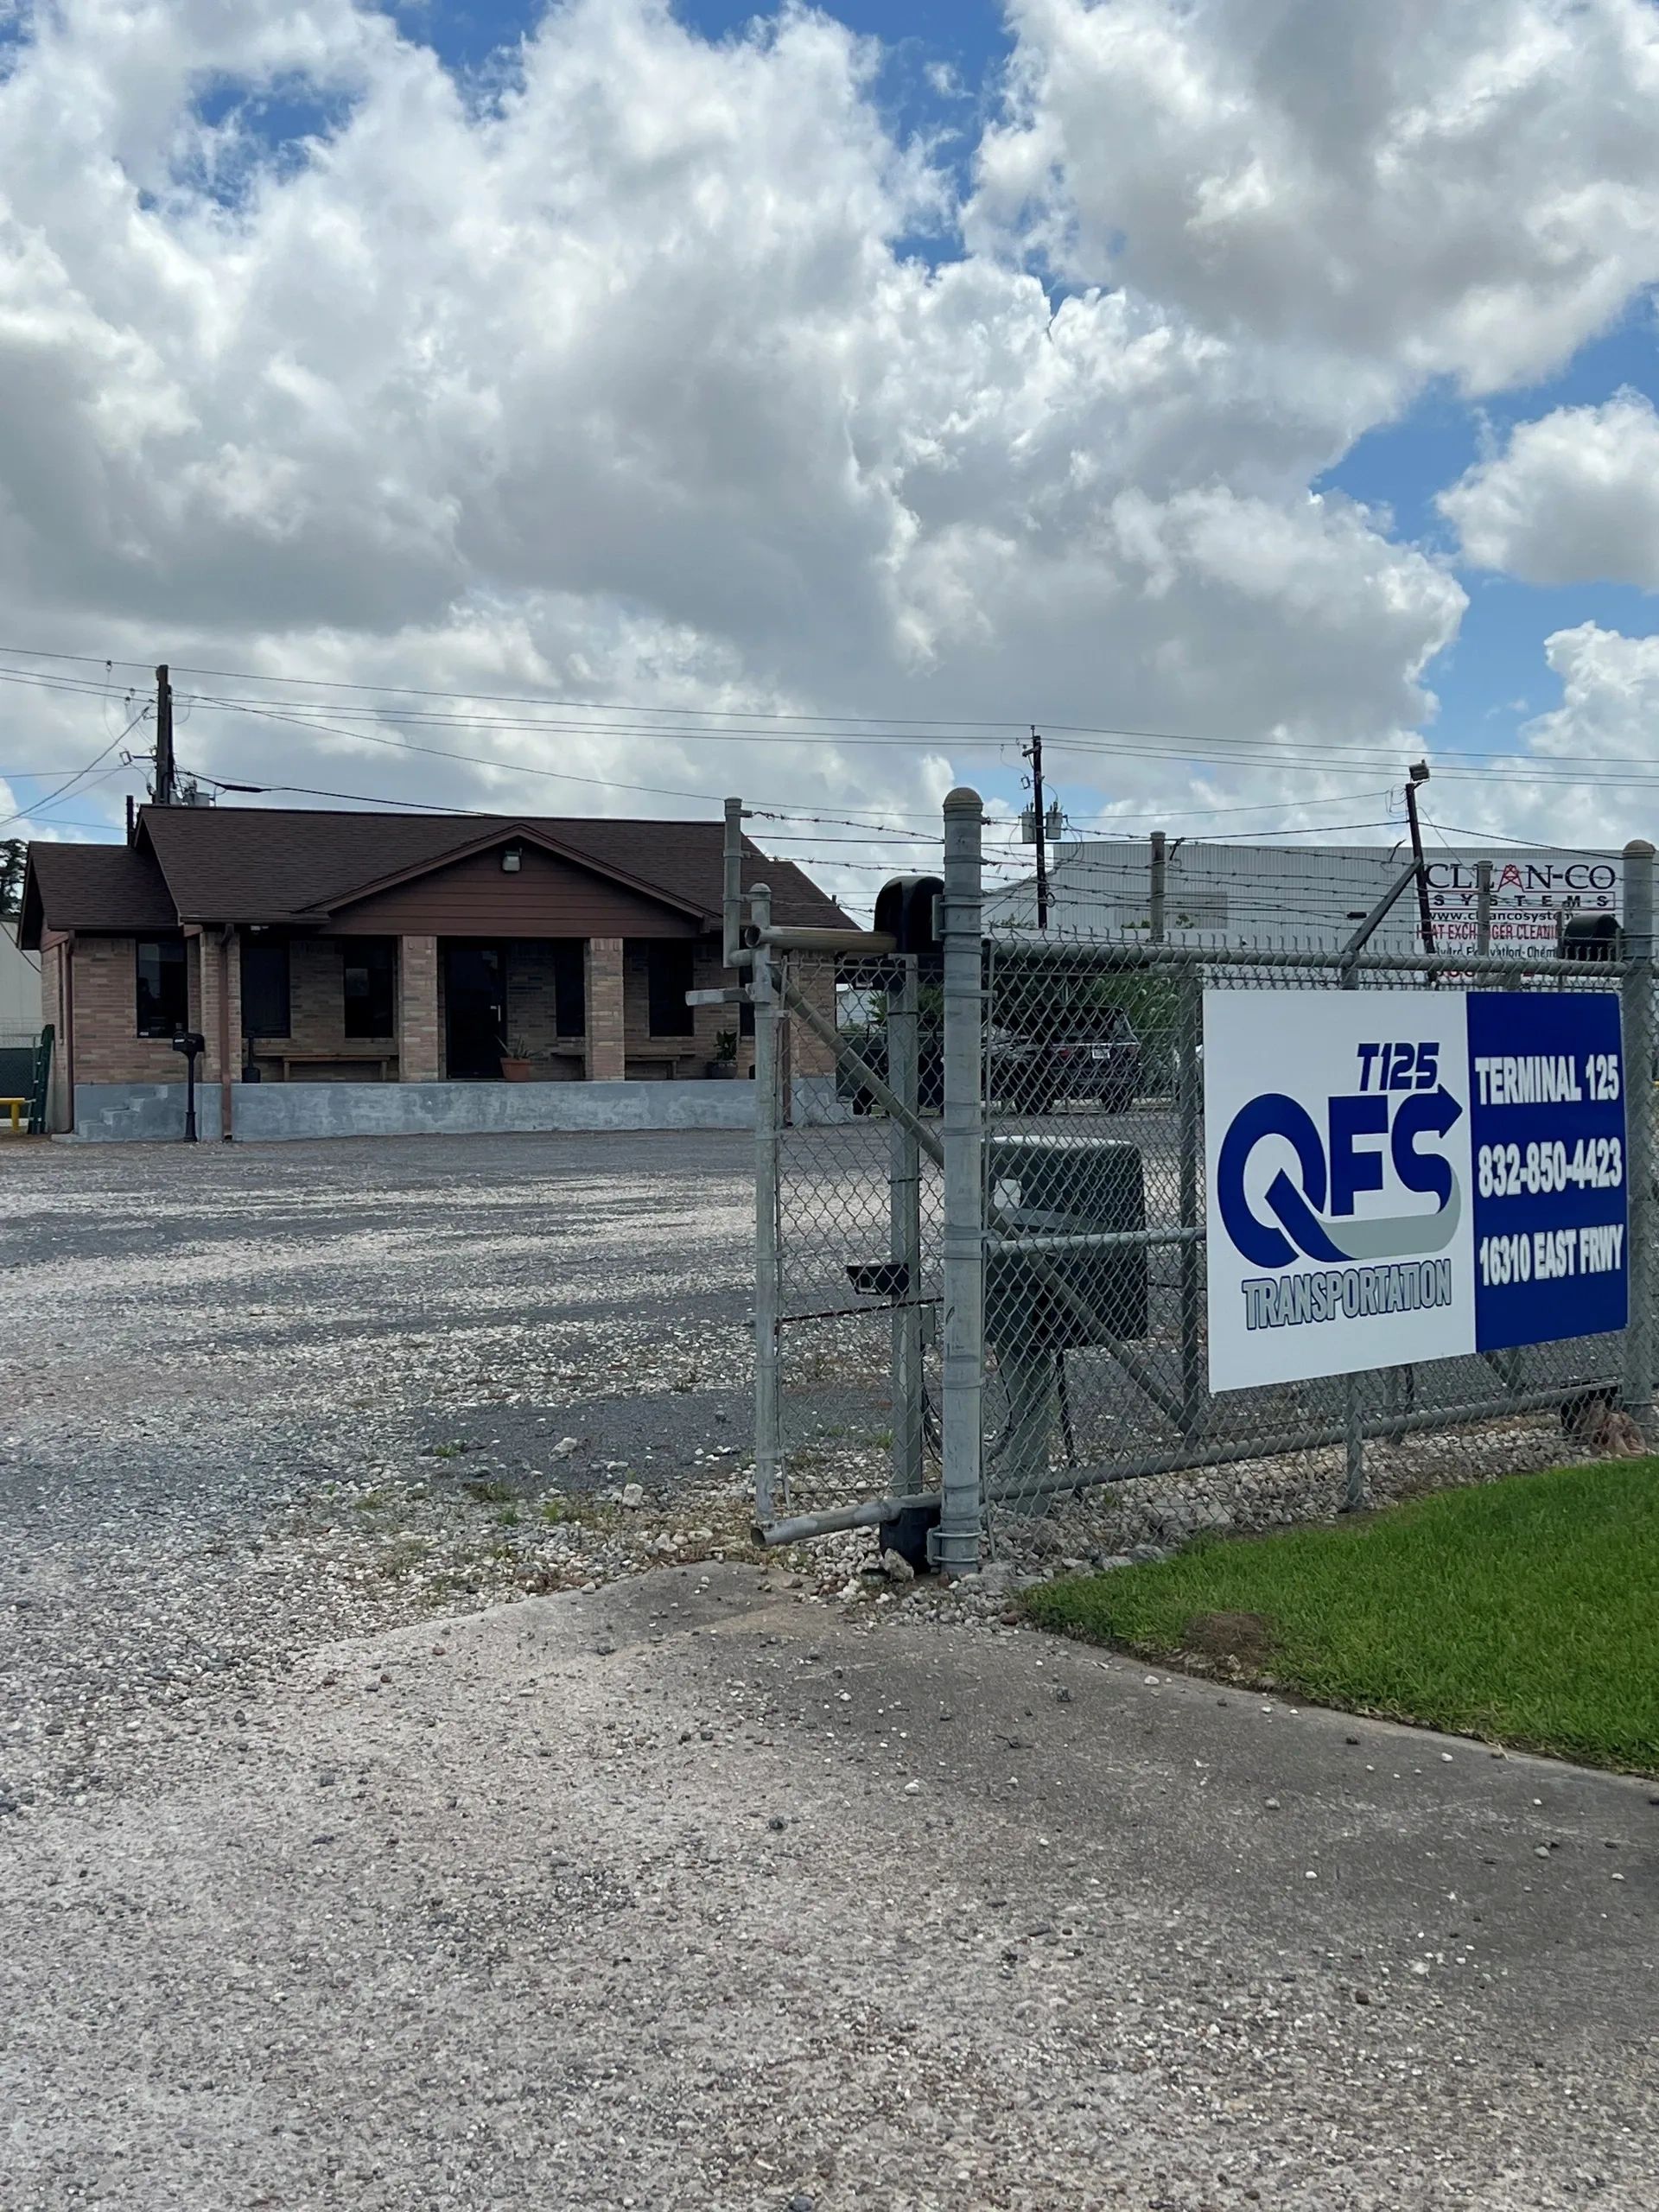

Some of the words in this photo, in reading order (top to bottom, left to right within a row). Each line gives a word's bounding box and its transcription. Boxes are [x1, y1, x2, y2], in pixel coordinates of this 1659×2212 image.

[1433, 894, 1607, 907] SYSTEMS
[1416, 925, 1445, 940] HAT
[1448, 925, 1513, 940] EXCHGER
[1357, 1042, 1440, 1091] T125
[1475, 1055, 1582, 1105] TERMINAL
[1586, 1054, 1619, 1101] 125
[1217, 1084, 1463, 1268] QFS
[1478, 1137, 1622, 1198] 832-850-4423
[1479, 1233, 1531, 1286] 16310
[1534, 1230, 1577, 1280] EAST
[1580, 1224, 1624, 1274] FRWY
[1242, 1259, 1452, 1331] TRANSPORTATION
